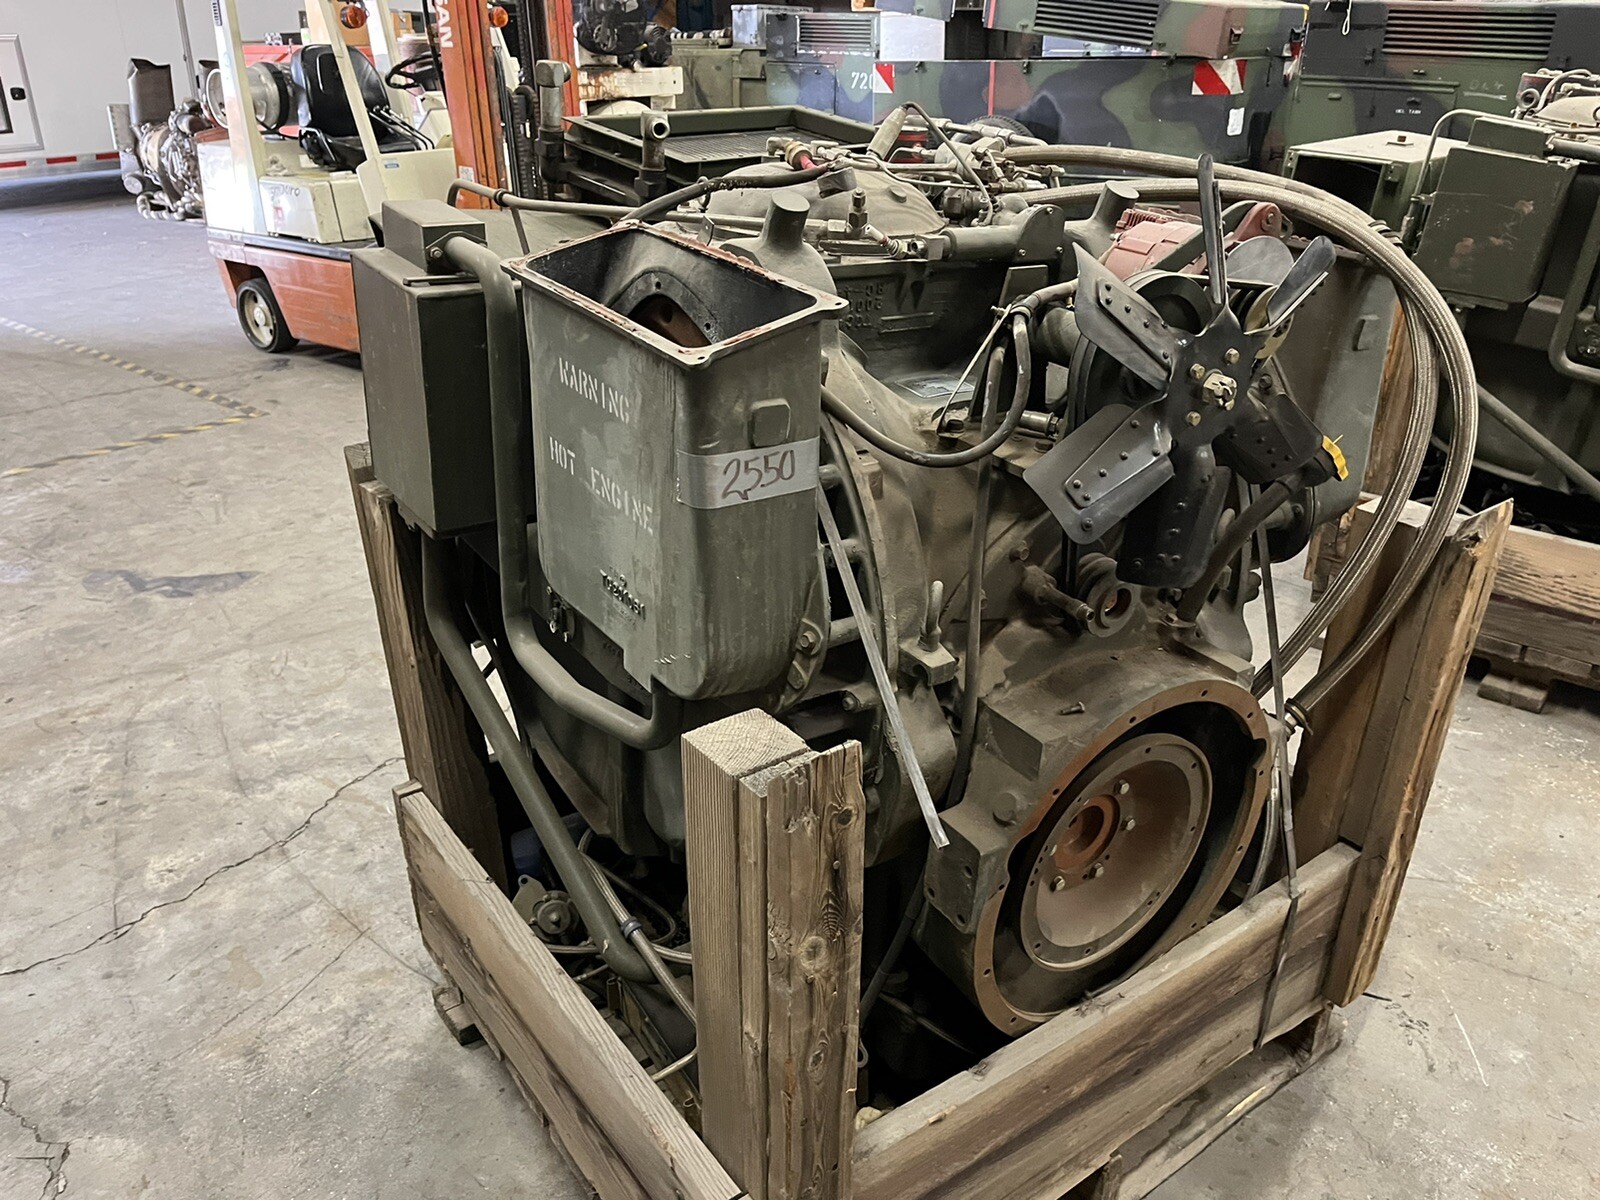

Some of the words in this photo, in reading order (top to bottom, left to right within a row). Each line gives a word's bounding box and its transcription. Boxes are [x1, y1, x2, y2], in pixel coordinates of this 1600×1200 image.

[549, 436, 576, 476] HOT
[590, 466, 653, 536] ENGINE
[721, 449, 796, 500] 2550
